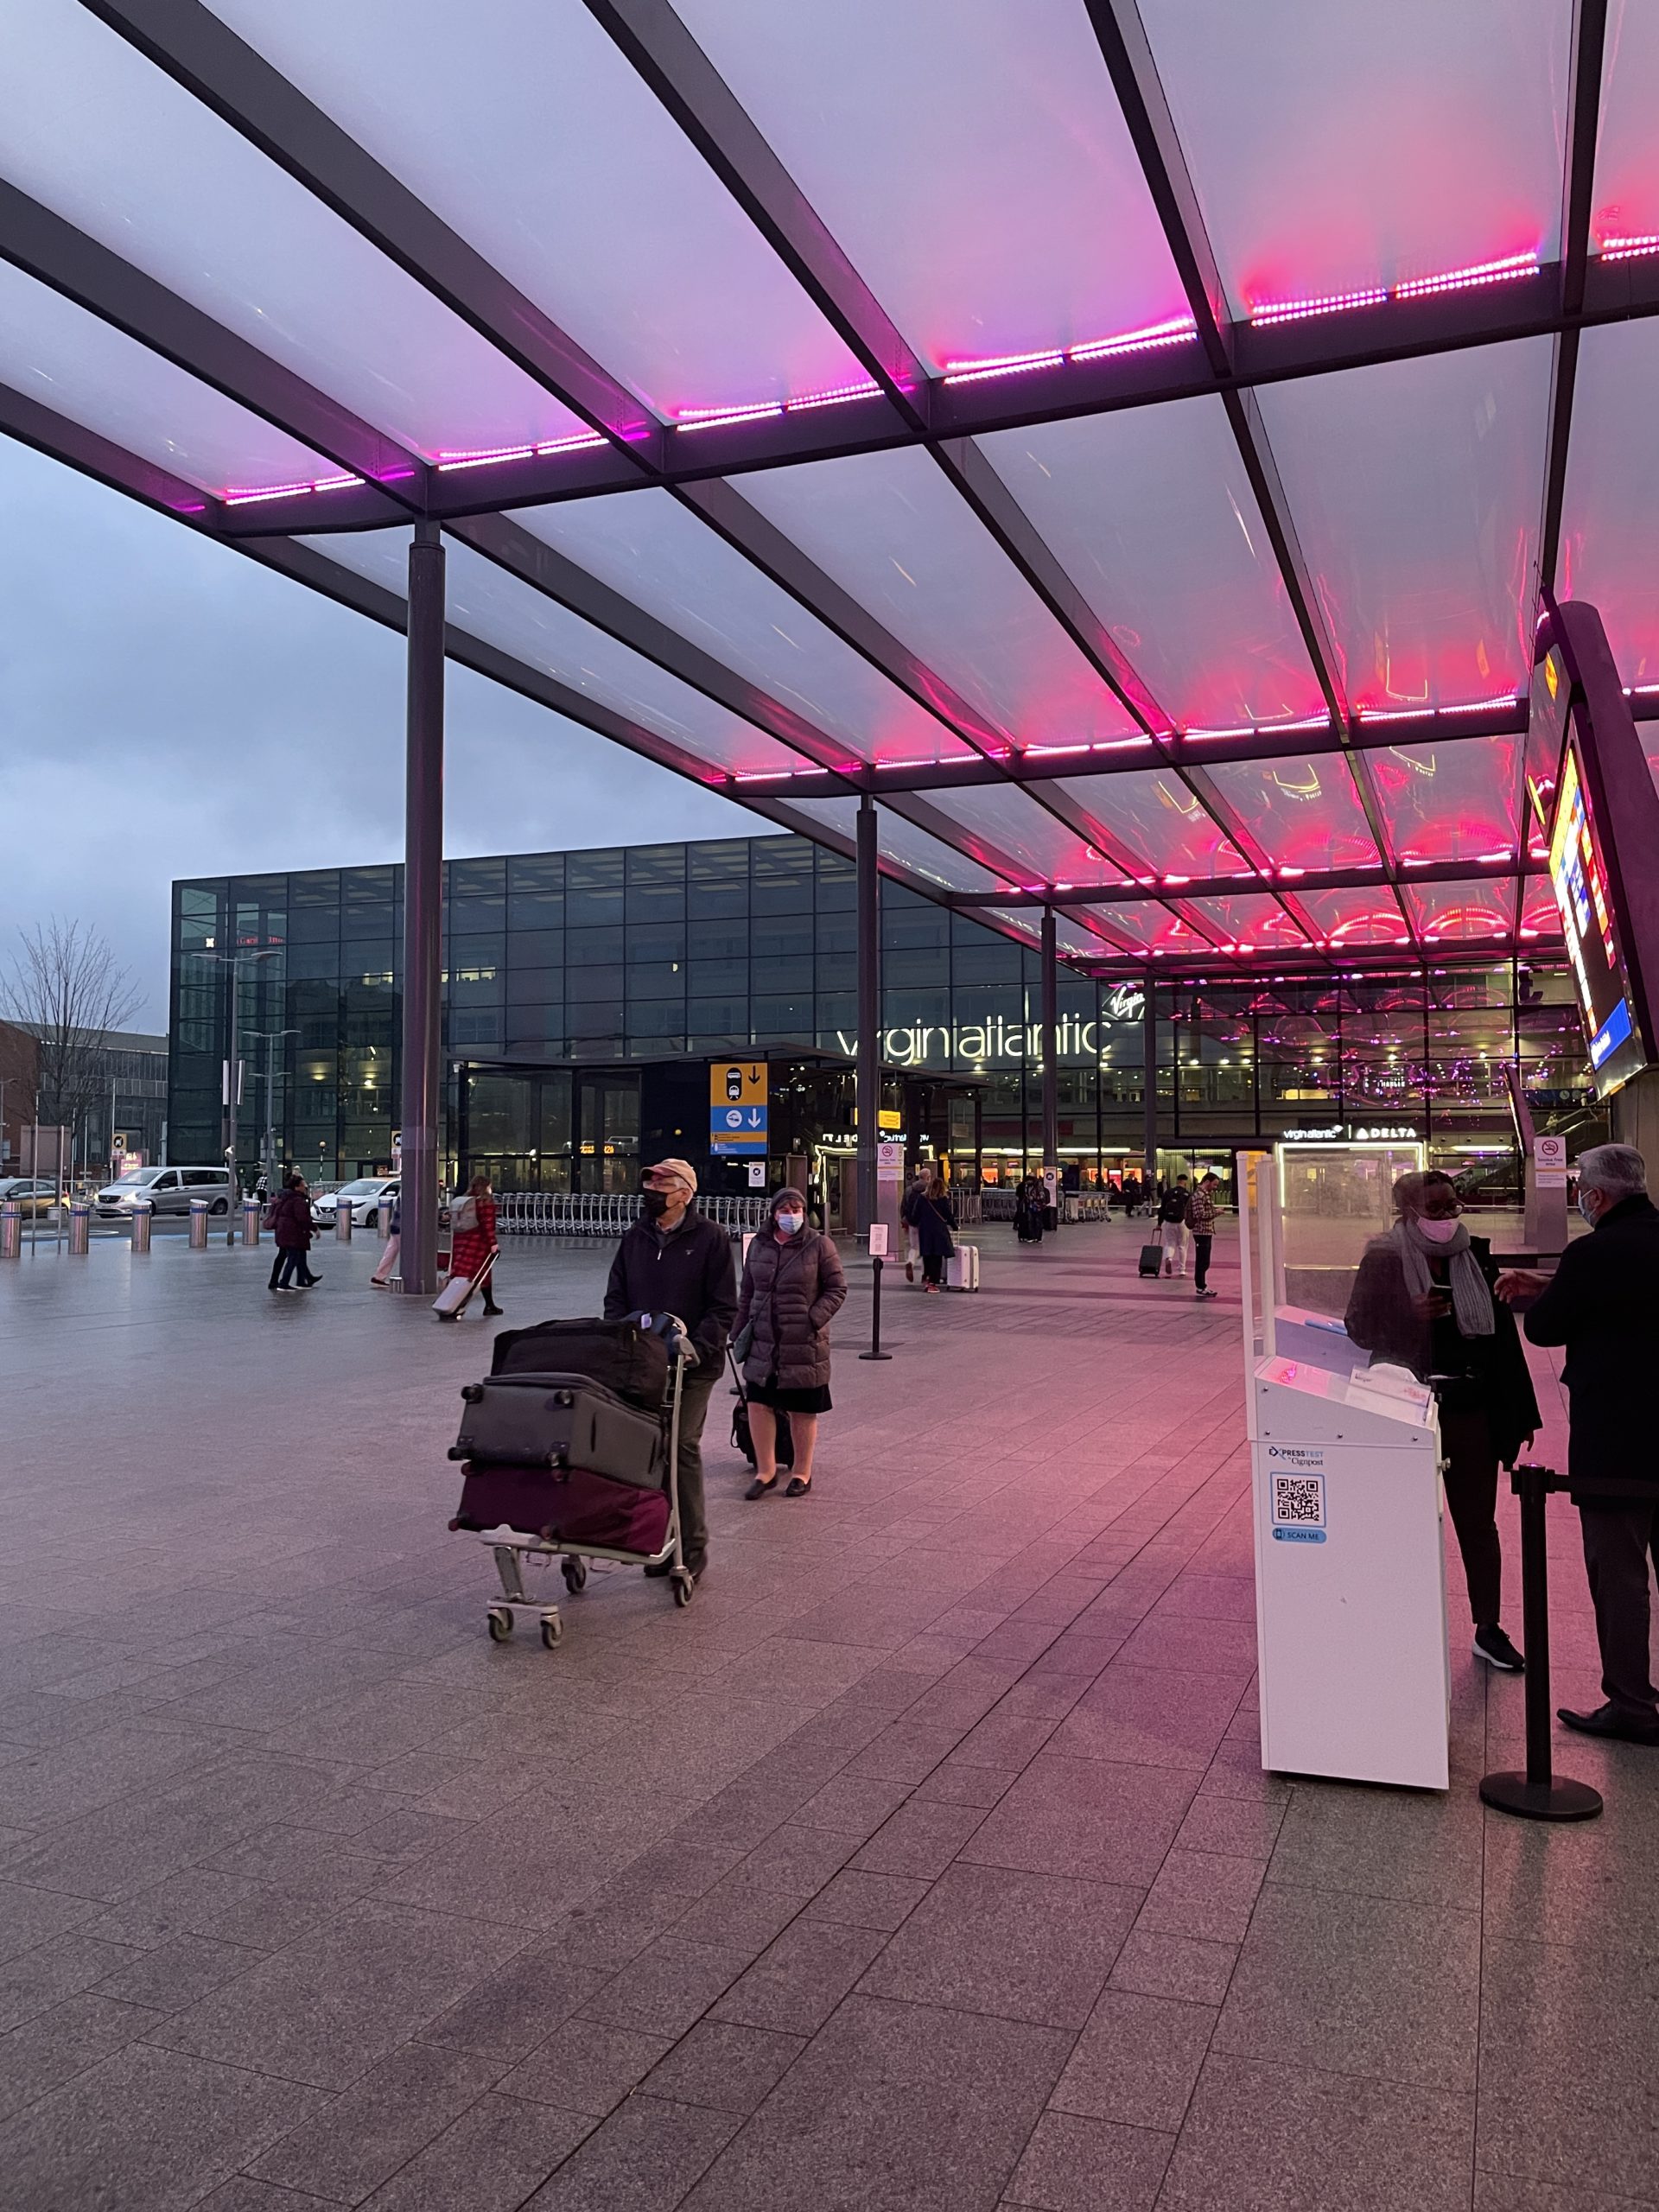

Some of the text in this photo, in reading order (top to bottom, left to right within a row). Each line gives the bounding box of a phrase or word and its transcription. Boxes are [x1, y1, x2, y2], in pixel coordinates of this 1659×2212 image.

[1110, 986, 1146, 1018] Virgin
[836, 1018, 949, 1066] vgin
[1370, 1128, 1417, 1138] DELTA
[1291, 1457, 1324, 1467] Cignpost
[1287, 1531, 1306, 1540] SCAN
